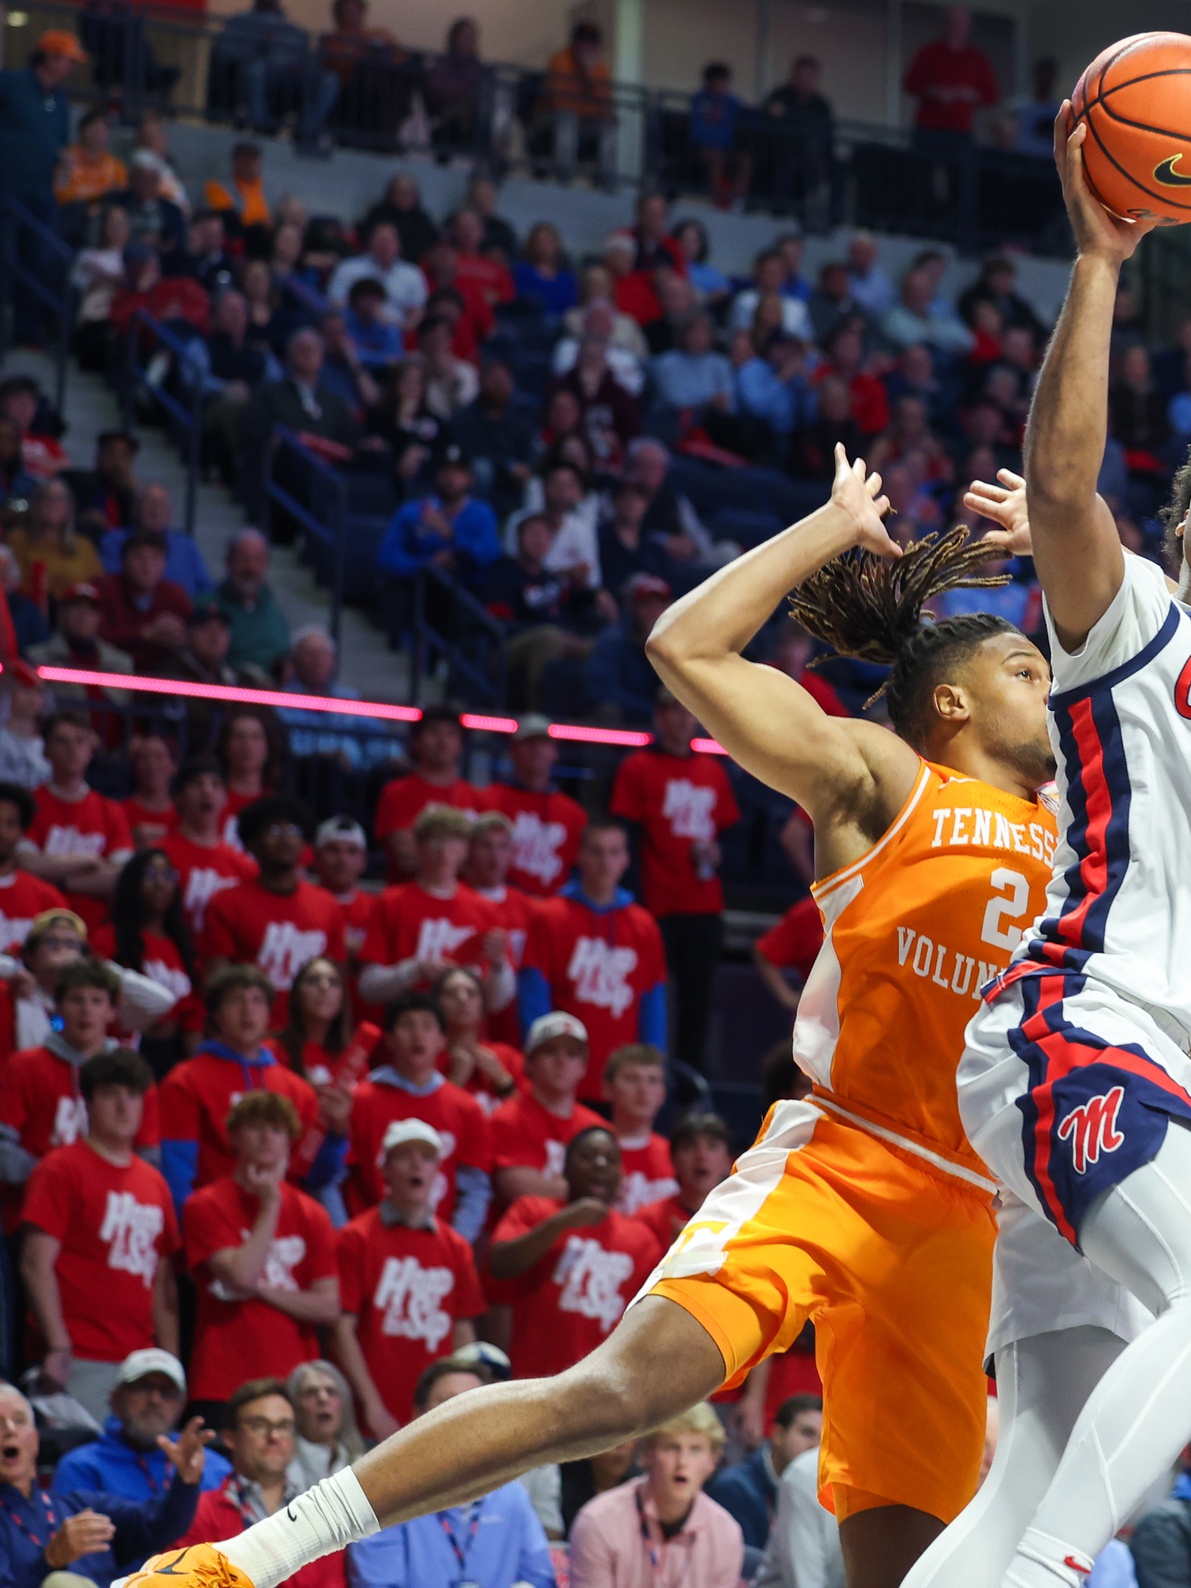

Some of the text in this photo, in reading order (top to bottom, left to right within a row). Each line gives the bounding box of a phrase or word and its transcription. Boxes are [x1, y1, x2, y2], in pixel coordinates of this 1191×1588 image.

[931, 807, 1059, 870] TENNESS
[980, 866, 1031, 952] 2
[896, 926, 1008, 1001] VOLUN
[1057, 1085, 1125, 1175] M
